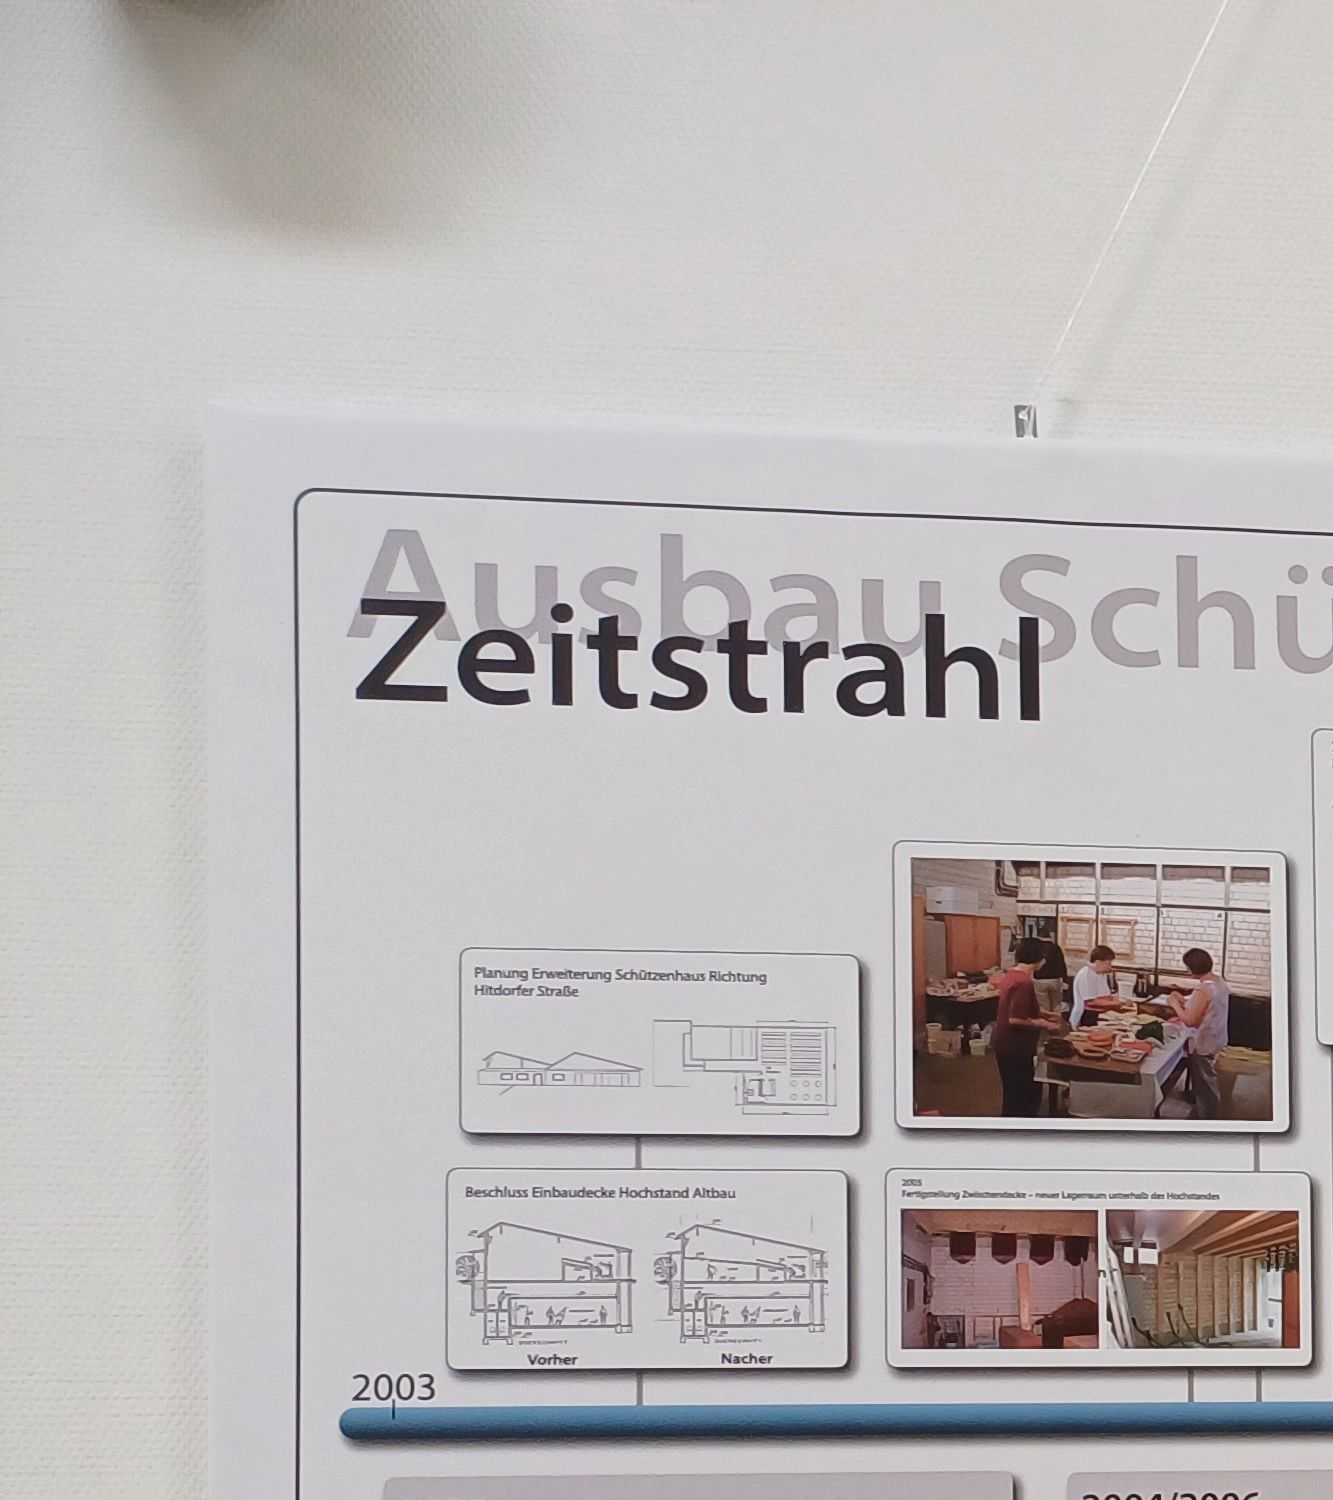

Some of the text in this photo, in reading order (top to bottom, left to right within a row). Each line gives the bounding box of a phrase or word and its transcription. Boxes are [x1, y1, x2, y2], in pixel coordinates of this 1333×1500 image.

[346, 528, 942, 660] Ausbau
[355, 597, 1041, 722] Zeitstrahl
[465, 1185, 737, 1198] Beschluss Einbaudecke Hochstand Altbau
[526, 1353, 581, 1369] Vorher
[720, 1352, 774, 1368] Nacher
[352, 1373, 436, 1401] 2003
